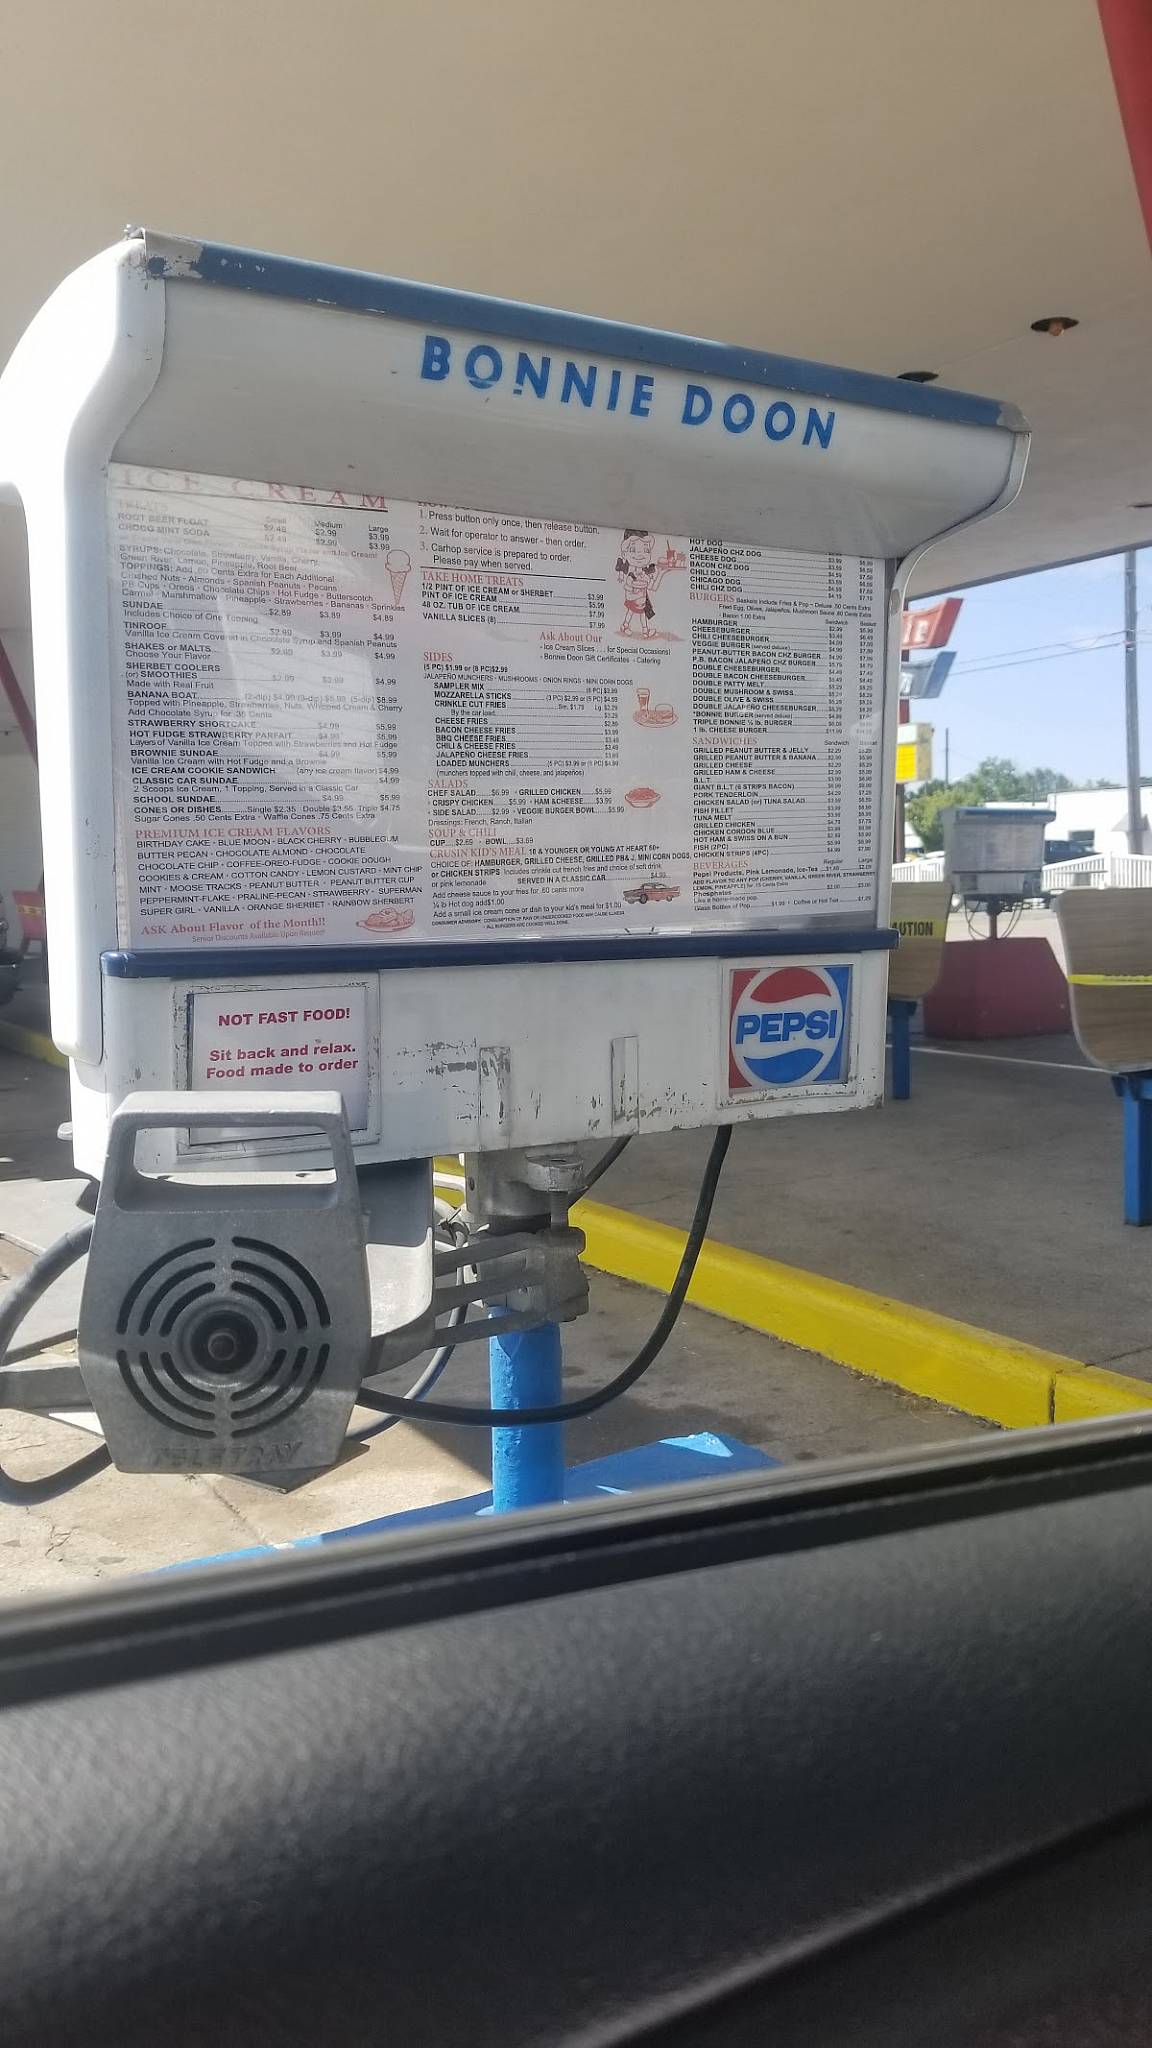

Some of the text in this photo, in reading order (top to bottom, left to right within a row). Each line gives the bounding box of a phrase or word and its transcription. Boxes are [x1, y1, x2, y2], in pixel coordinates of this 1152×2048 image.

[420, 335, 836, 449] BONNIE DOON
[231, 480, 388, 509] CREAM
[428, 510, 453, 521] Press
[453, 513, 480, 525] button
[481, 516, 500, 526] only
[500, 517, 523, 528] once,
[523, 519, 542, 530] then
[543, 521, 572, 533] release
[368, 525, 388, 533] Large
[430, 527, 450, 538] Wait
[450, 529, 463, 539] for
[463, 530, 498, 541] operator
[499, 532, 508, 542] to
[509, 533, 539, 544] answer
[545, 536, 563, 546] then
[564, 537, 588, 548] order.
[462, 546, 493, 557] service
[493, 548, 502, 557] is
[502, 548, 538, 560] prepared
[538, 551, 548, 561] to
[548, 551, 571, 562] order.
[689, 554, 719, 562] CHEESE
[433, 556, 533, 571] Please pay when served.
[421, 571, 523, 586] TAKE HOME TREATS
[689, 593, 734, 602] BURGERS
[122, 601, 163, 610] SUNDAE
[422, 613, 456, 623] VANILLA
[458, 614, 485, 624] SLICES
[691, 618, 737, 626] HAMBURGER
[123, 622, 168, 630] TINROOF
[691, 626, 750, 634] CHEESEBURGER
[539, 632, 602, 643] Ask About Our
[124, 642, 211, 653] SHAKES or MALTS
[125, 651, 210, 661] Choose Your Flavor
[423, 652, 452, 662] SIDES
[125, 663, 220, 672] SHERBET COOLERS
[140, 671, 197, 680] SMOOTHIES
[126, 680, 214, 689] Made with Real Fruit
[433, 682, 470, 690] SAMPLER
[127, 691, 198, 699] BANANA BOAT
[485, 692, 512, 700] STICKS
[127, 720, 196, 728] STRAWBERRY
[692, 737, 759, 745] SANDWICHES
[179, 749, 219, 757] SUNDAE
[199, 776, 239, 784] SUNDAE
[428, 779, 468, 788] SALADS
[133, 795, 216, 804] SCHOOL SUNDAE
[133, 805, 222, 814] CONES OR DISHES
[451, 808, 477, 816] SALAD
[135, 826, 332, 839] PREMIUM ICE CREAM FLAVORS
[428, 828, 457, 837] SOUP
[467, 828, 496, 837] CHILI
[136, 839, 183, 848] BIRTHDAY
[184, 839, 211, 847] CAKE
[216, 838, 242, 847] BLUE
[243, 838, 270, 846] MOON
[276, 837, 306, 845] BLACK
[306, 836, 342, 845] CHERRY
[693, 861, 748, 869] BEVERAGES
[141, 917, 326, 935] ASK About Flavor of the Month!!
[890, 922, 934, 937] AUTION
[218, 1008, 349, 1026] NOT FAST FOOD!
[736, 1009, 838, 1045] PEPSI
[209, 1043, 355, 1061] Sit back and relax.
[206, 1059, 358, 1078] Food made to order
